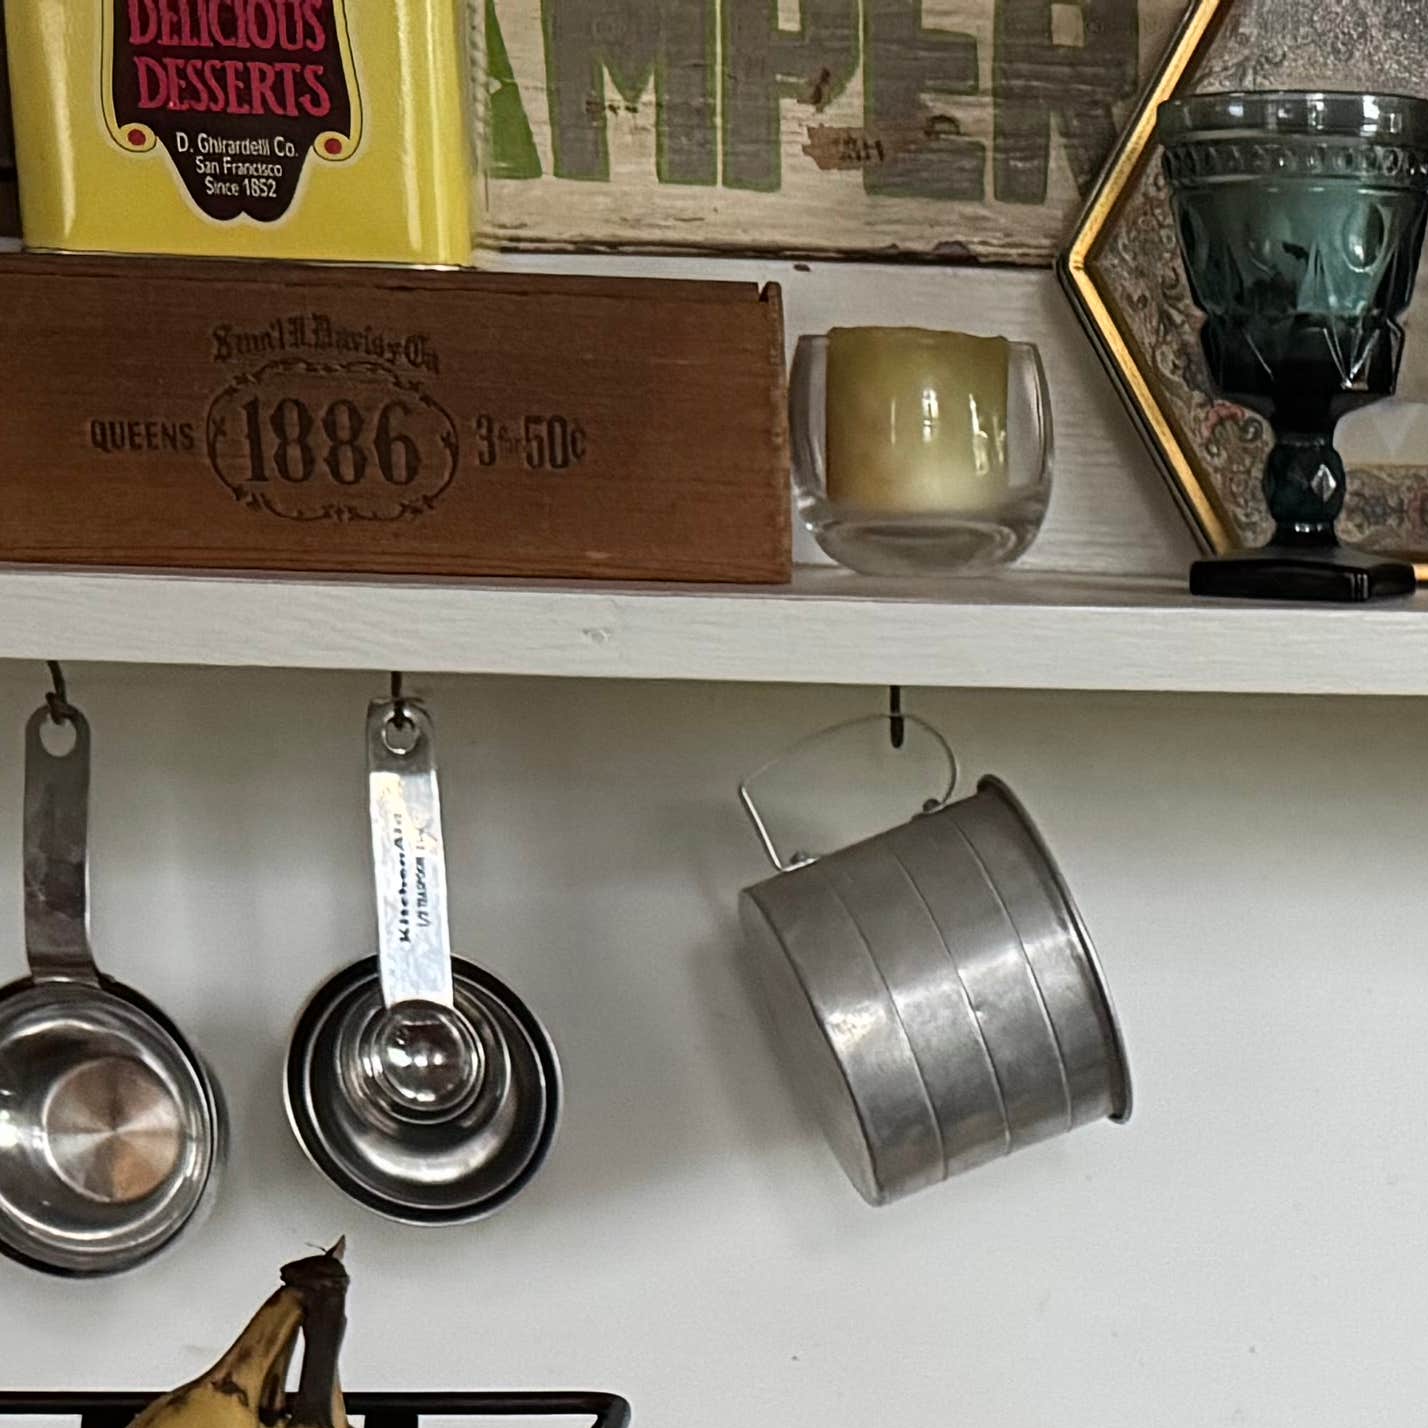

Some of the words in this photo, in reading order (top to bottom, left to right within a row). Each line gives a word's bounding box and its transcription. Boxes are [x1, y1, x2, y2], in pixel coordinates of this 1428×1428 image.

[128, 0, 326, 51] DELICIOUS
[134, 56, 331, 117] DESSERTS
[176, 132, 193, 152] D.
[197, 133, 271, 157] Ghirardelli
[274, 137, 299, 158] Co.
[196, 156, 219, 175] San
[223, 157, 283, 177] Francisco
[205, 177, 239, 197] Since
[243, 178, 277, 198] 1852
[89, 418, 196, 453] QUEENS
[240, 397, 423, 485] 1886
[473, 414, 498, 468] 3
